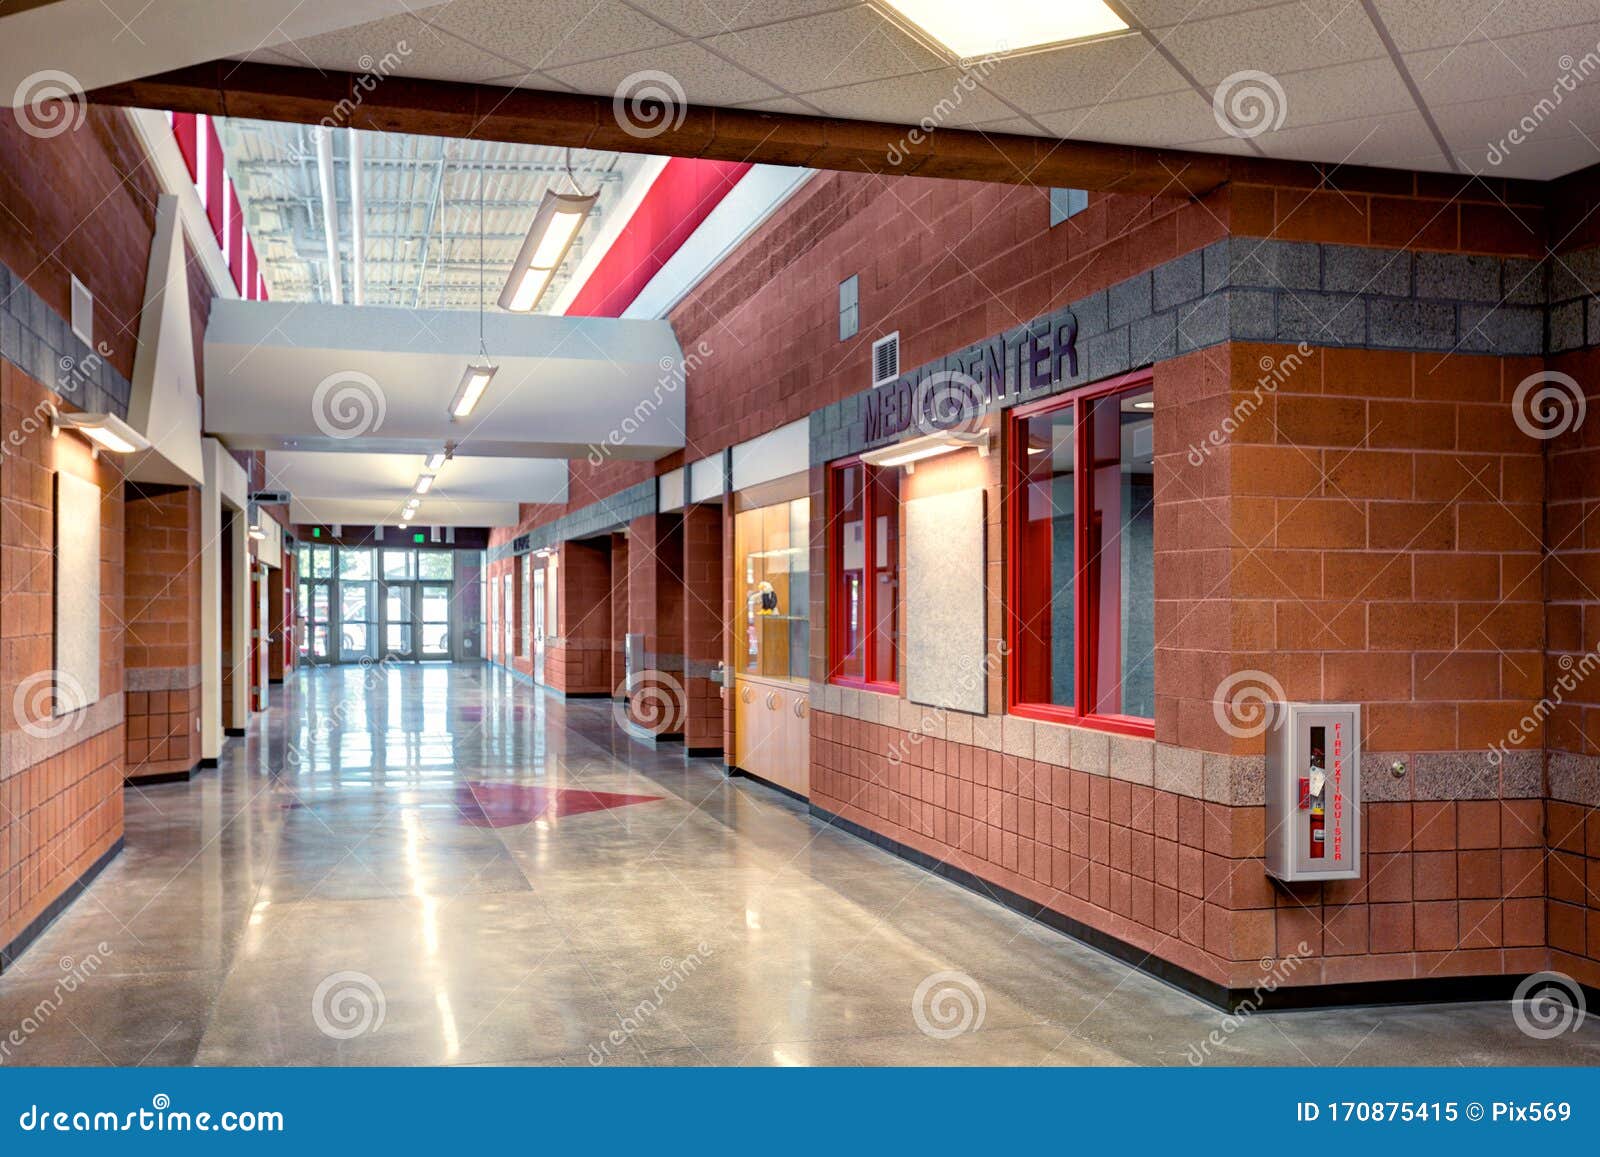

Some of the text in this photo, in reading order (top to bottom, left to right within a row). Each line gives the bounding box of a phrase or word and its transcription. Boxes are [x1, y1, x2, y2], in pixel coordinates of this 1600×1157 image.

[864, 311, 1079, 444] MEDIA CENTER
[1334, 723, 1342, 861] FIRE EXTINGUISHER
